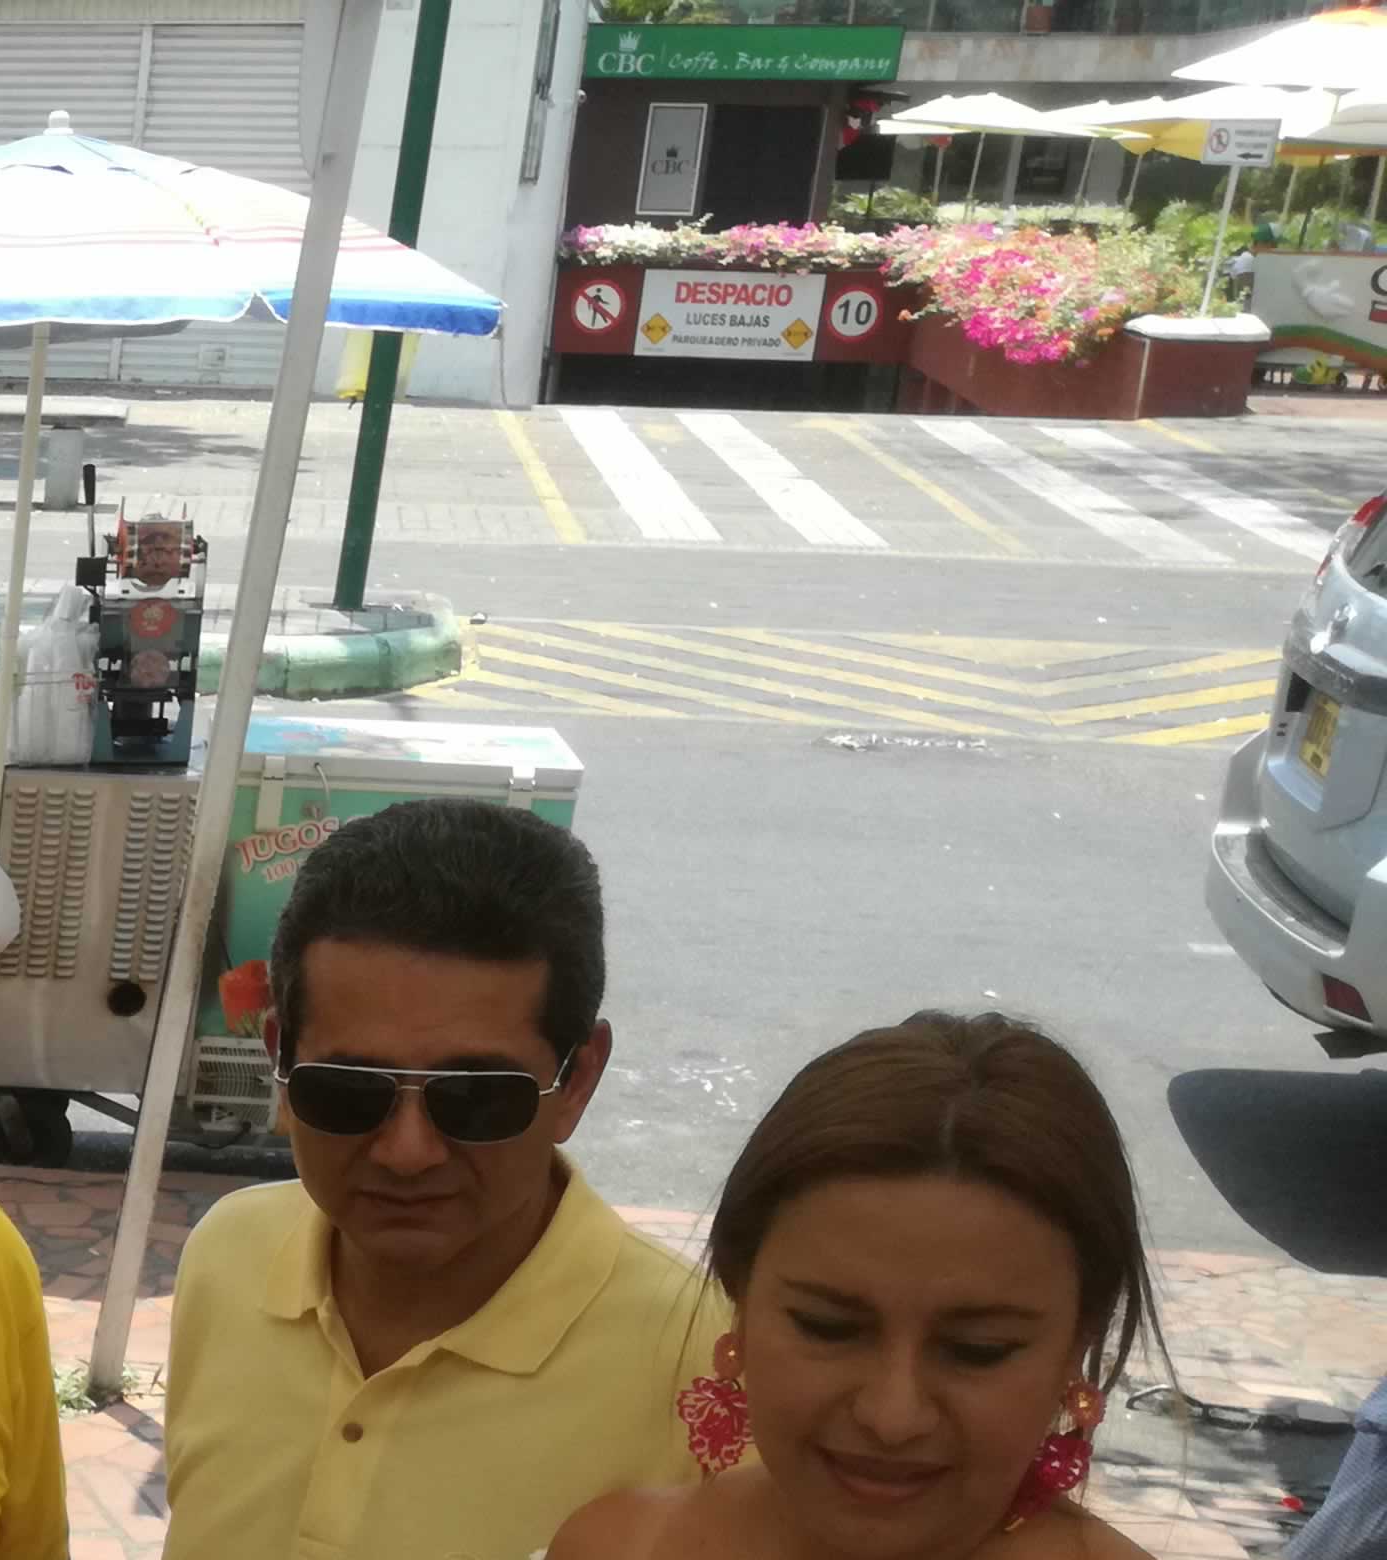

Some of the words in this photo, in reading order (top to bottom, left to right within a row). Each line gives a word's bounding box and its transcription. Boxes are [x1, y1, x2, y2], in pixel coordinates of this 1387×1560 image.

[597, 51, 655, 75] CBC
[674, 281, 794, 307] DESPACIO
[685, 311, 727, 326] LUCES
[729, 314, 771, 328] BAJAS
[837, 299, 873, 326] 10
